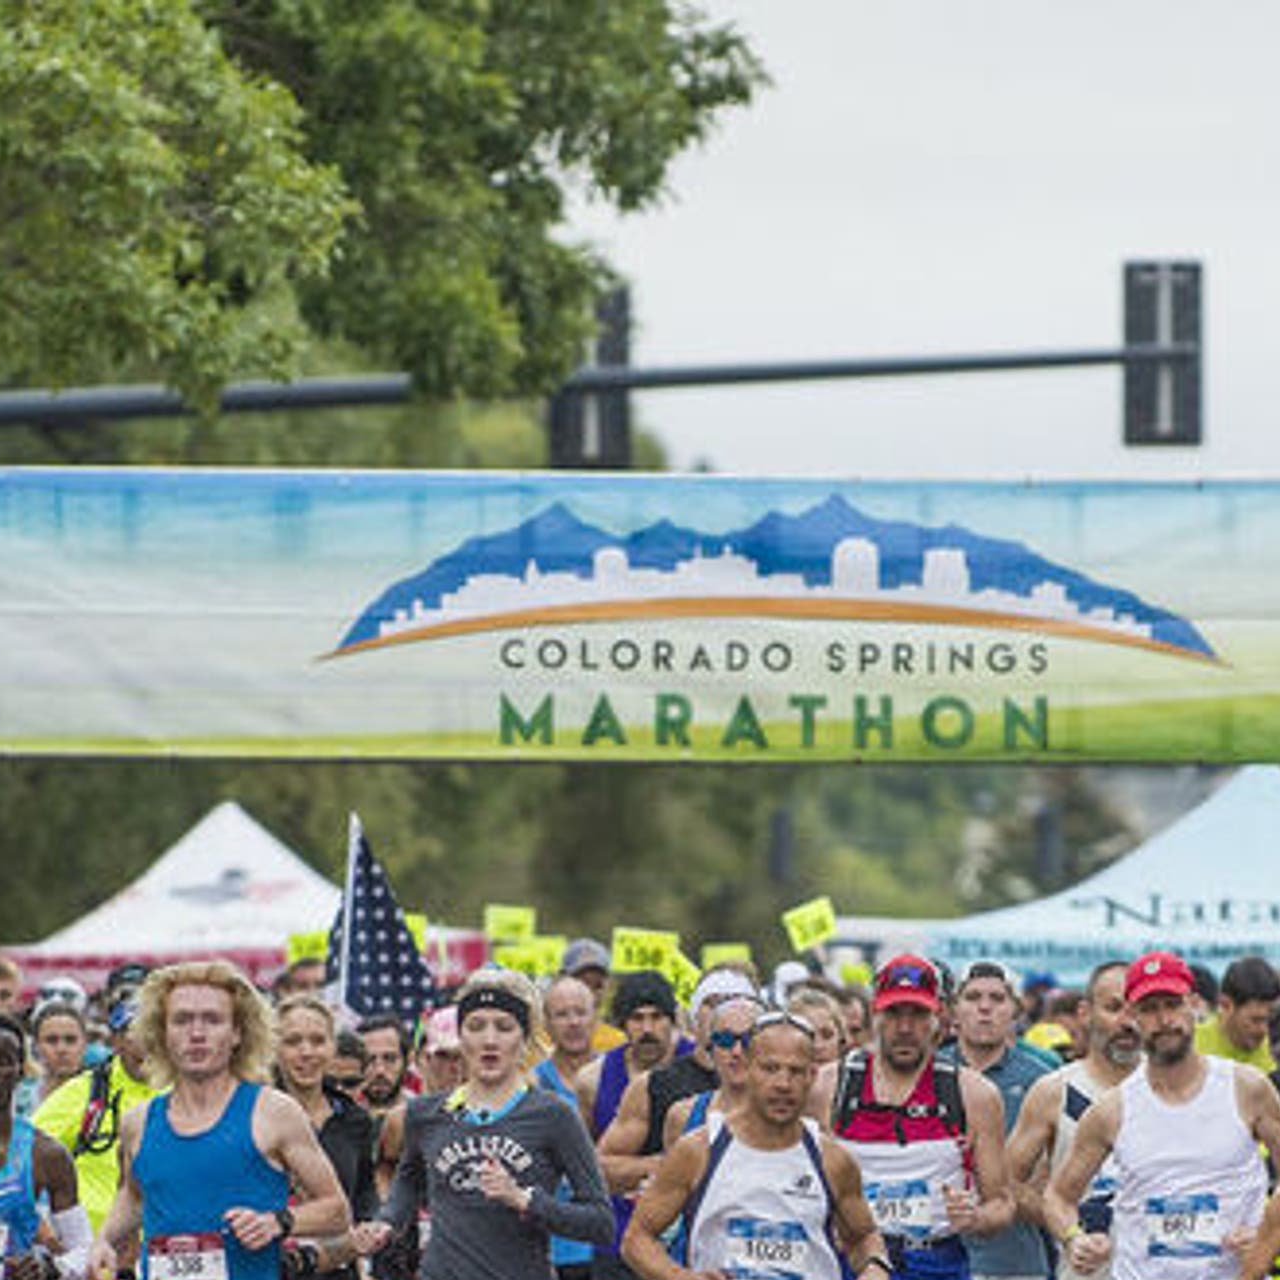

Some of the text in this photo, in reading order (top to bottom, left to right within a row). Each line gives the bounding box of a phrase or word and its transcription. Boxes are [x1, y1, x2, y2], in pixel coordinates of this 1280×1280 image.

[499, 638, 1051, 674] COLORADO SPRINGS
[498, 692, 1051, 750] MARATHON
[743, 1238, 793, 1261] 1028
